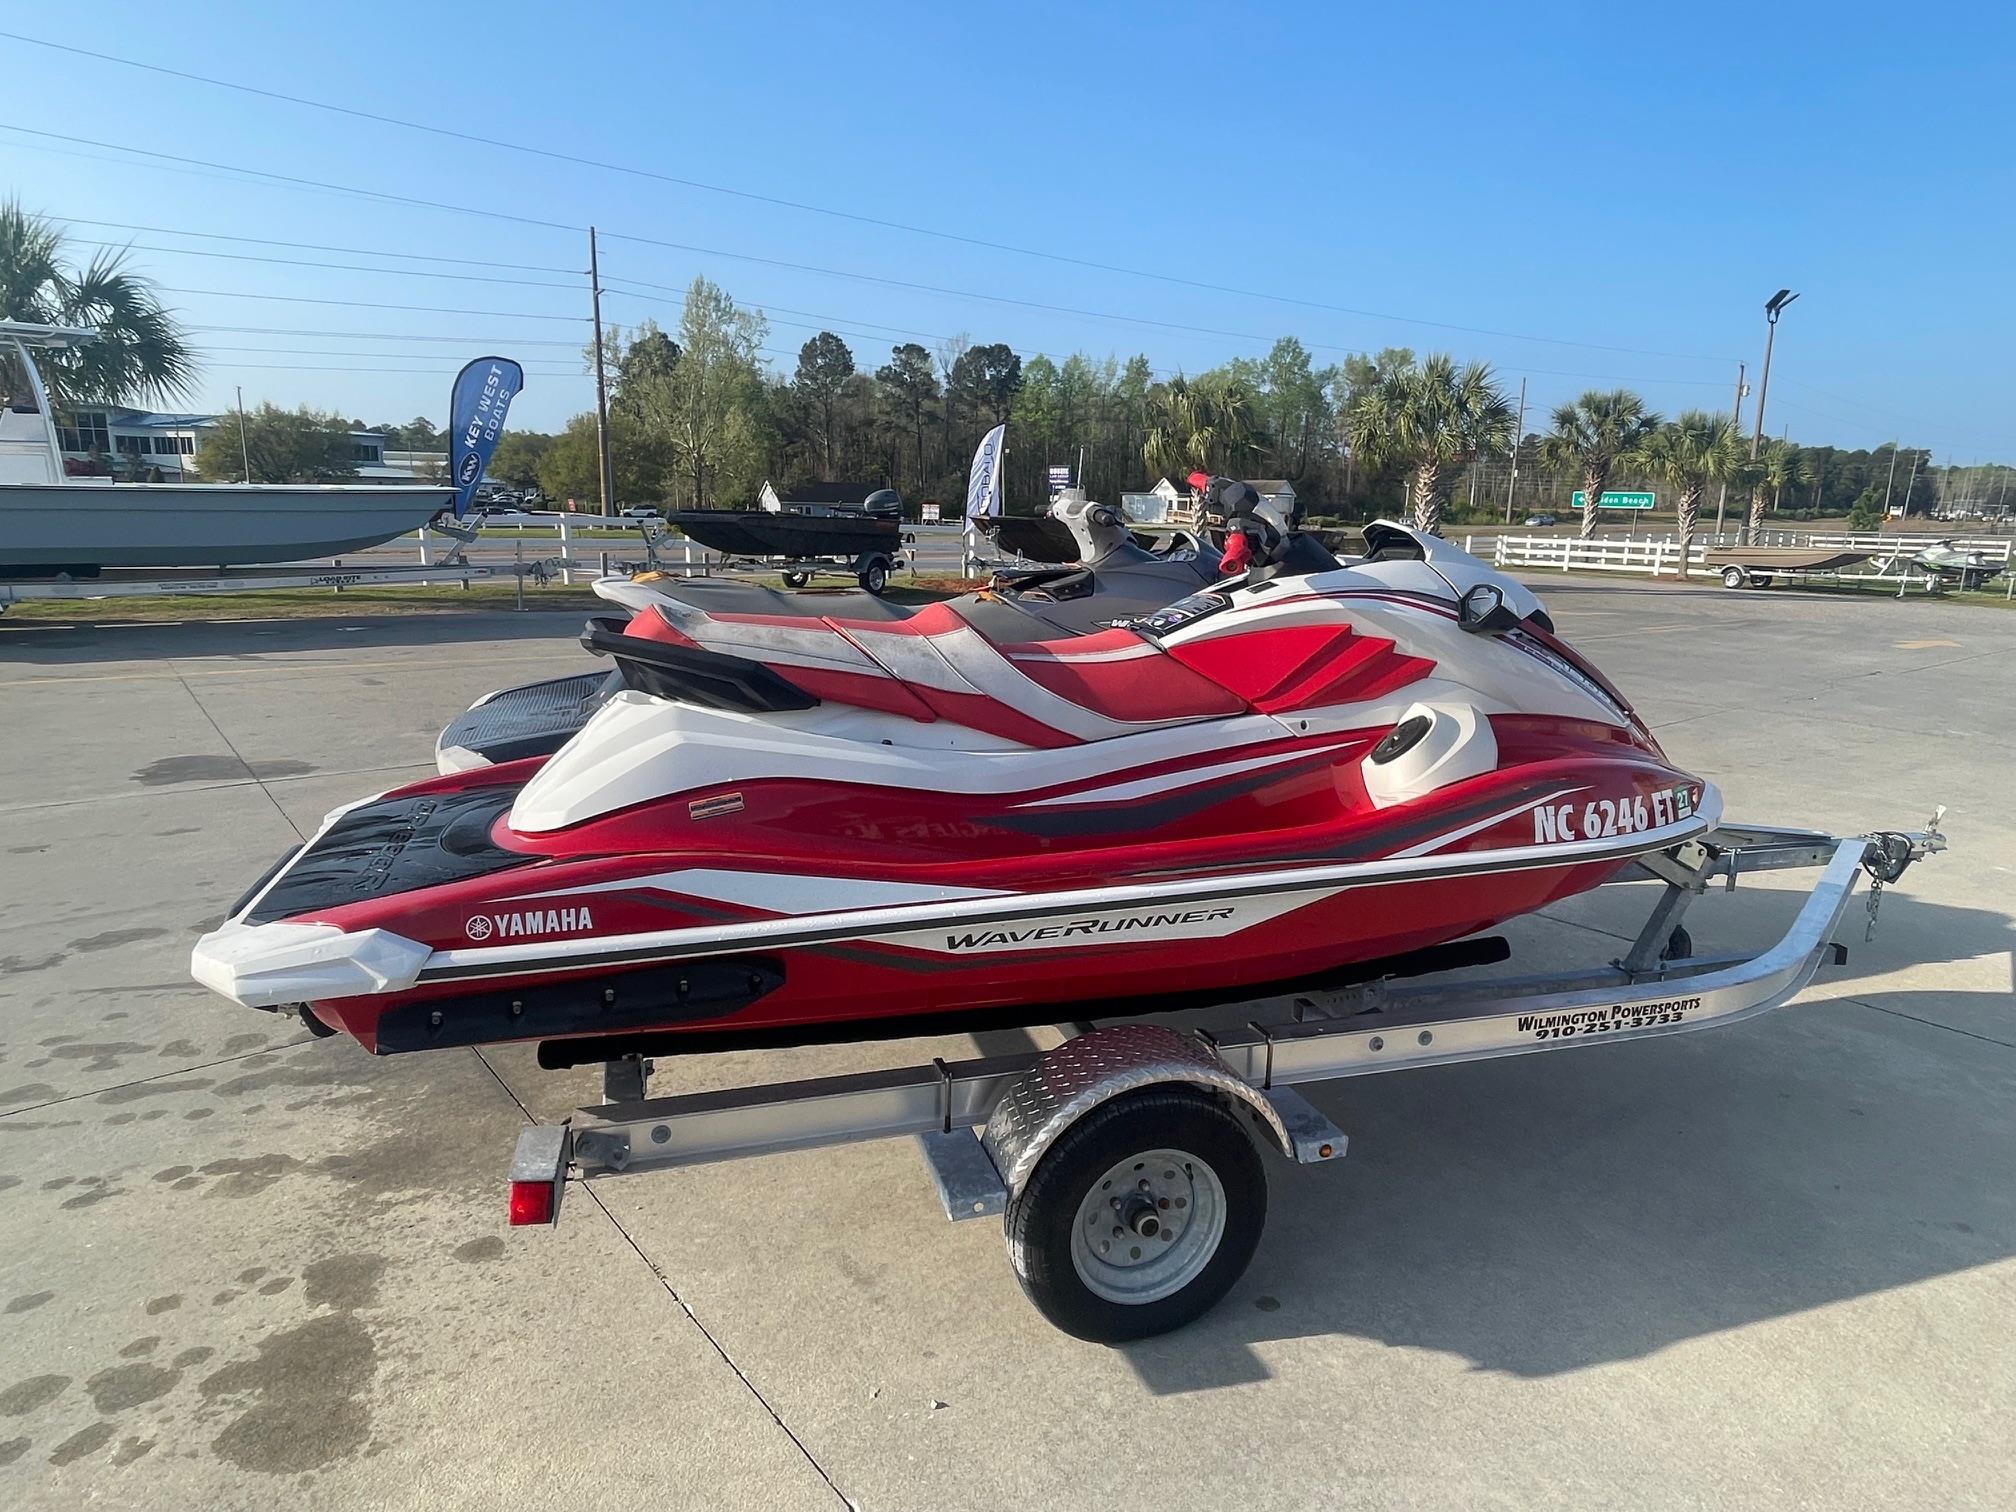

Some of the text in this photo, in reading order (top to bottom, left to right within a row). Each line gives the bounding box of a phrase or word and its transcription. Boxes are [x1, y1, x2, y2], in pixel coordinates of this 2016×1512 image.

[464, 364, 503, 448] KEY WEST
[484, 388, 510, 441] BOATS
[461, 454, 479, 482] KW
[1622, 496, 1649, 504] Beach
[1534, 788, 1676, 844] NC 6246 ET
[494, 906, 593, 938] YAMAHA
[946, 907, 1235, 950] WAVERUNNER
[1518, 998, 1702, 1032] WILMINGTON POWERSPORTS
[1535, 1012, 1684, 1041] 910-251-3733
